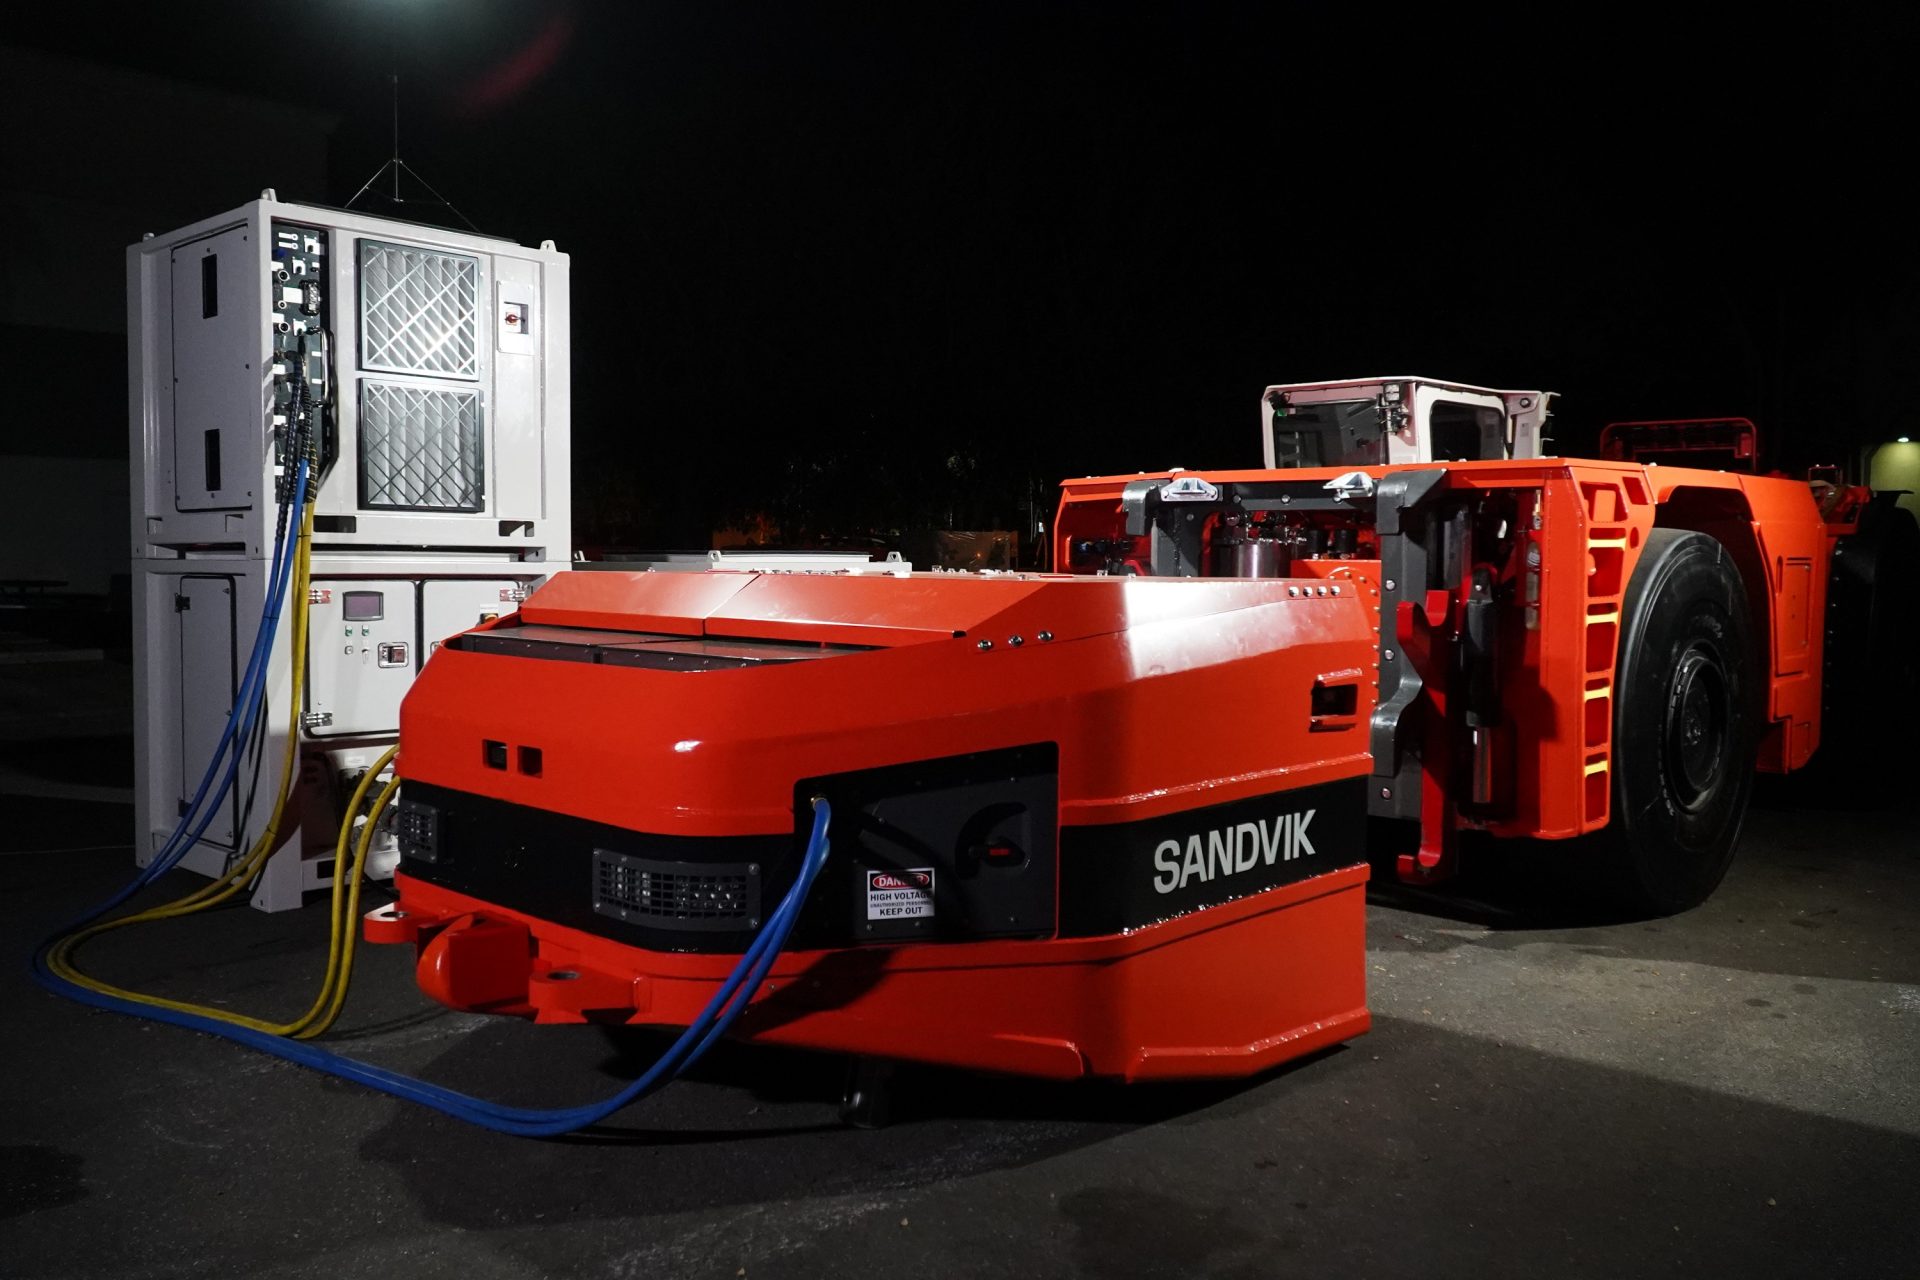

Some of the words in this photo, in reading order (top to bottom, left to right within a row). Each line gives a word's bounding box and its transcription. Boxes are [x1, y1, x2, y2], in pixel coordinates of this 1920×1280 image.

[1153, 809, 1317, 895] SANDVIK
[878, 875, 925, 887] DANR
[870, 893, 892, 901] HIGH
[879, 908, 903, 916] KEEP
[905, 907, 922, 915] OUT
